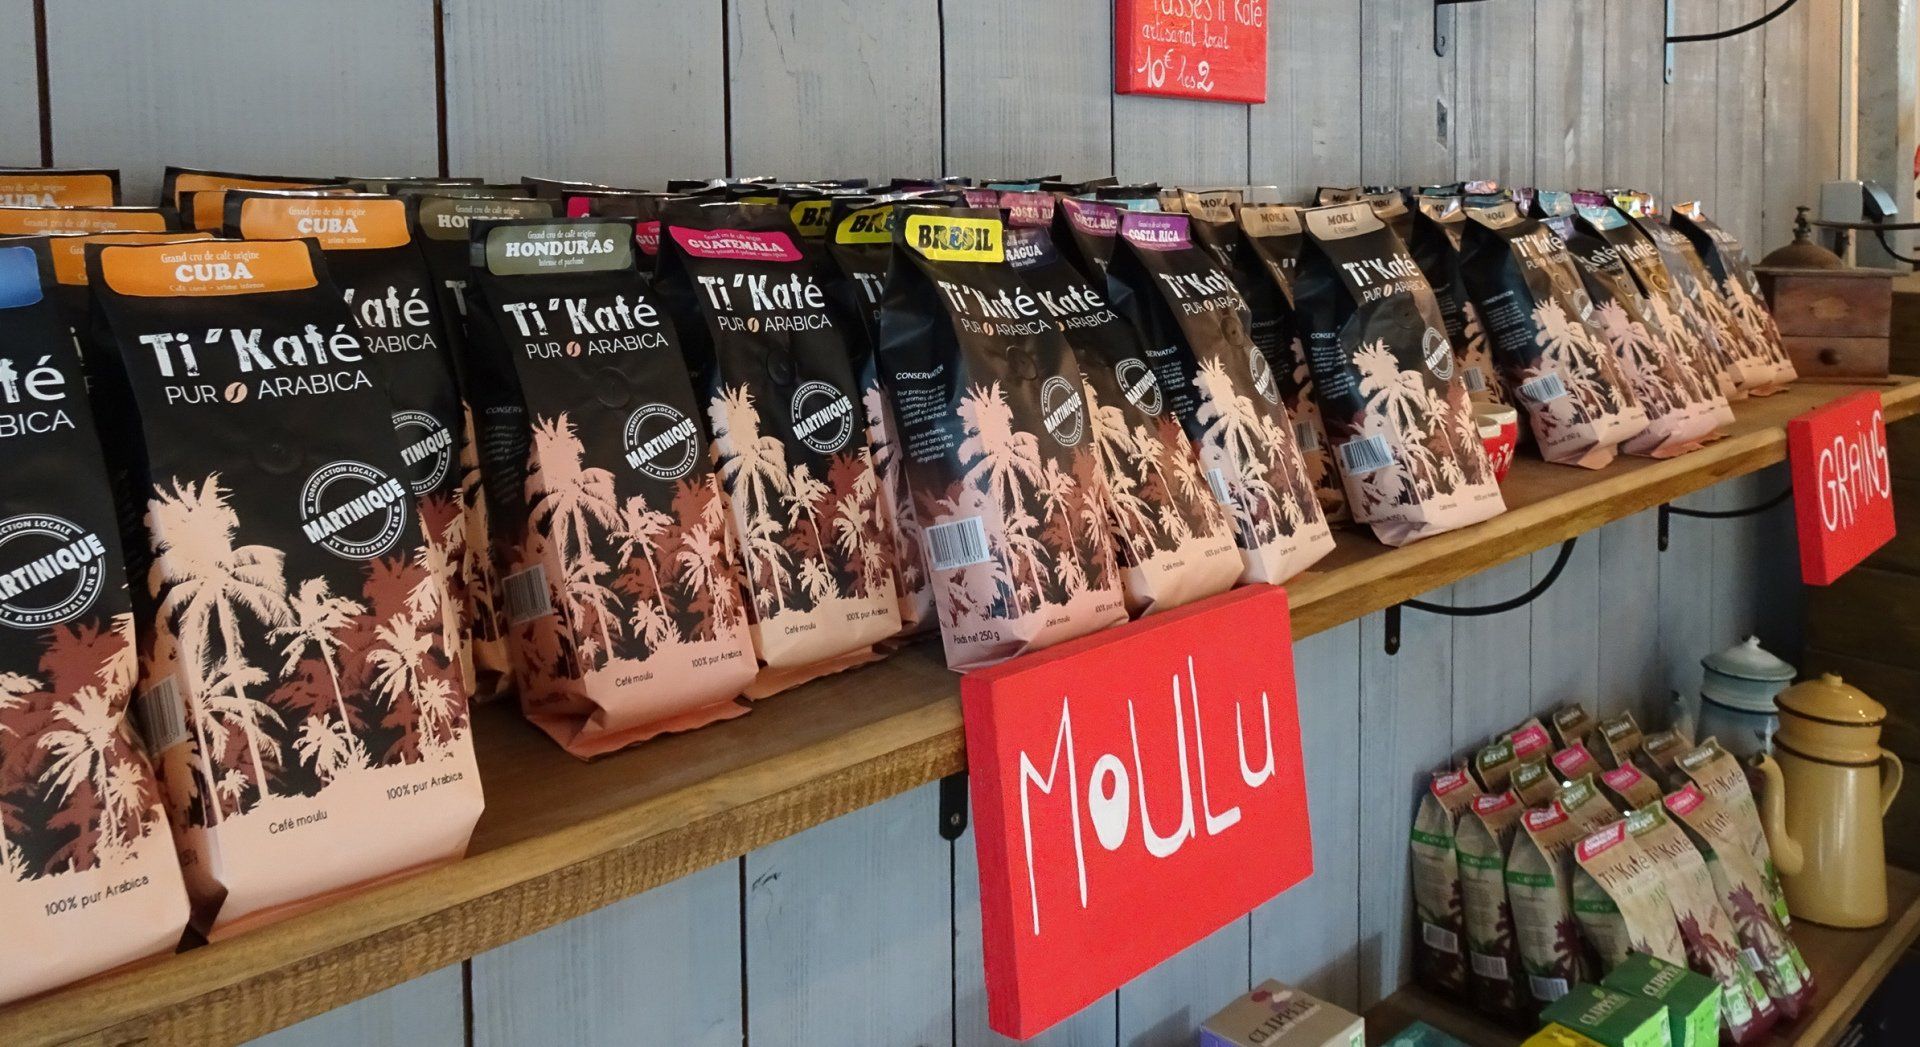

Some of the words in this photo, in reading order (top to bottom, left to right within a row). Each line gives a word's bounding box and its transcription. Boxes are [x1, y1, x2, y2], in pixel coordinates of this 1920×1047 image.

[1010, 206, 1039, 219] COSTA
[1200, 197, 1229, 209] MOKA
[297, 217, 359, 234] CUBA
[1260, 213, 1290, 224] MOKA
[1327, 213, 1356, 226] MOKA
[1128, 228, 1156, 242] COSTA
[1158, 229, 1180, 242] RICA
[505, 238, 615, 258] HONDURAS
[687, 238, 785, 253] GUATEMALA
[1005, 244, 1043, 262] RAGUA
[175, 262, 254, 283] CUBA
[1363, 287, 1382, 303] PUR
[1182, 301, 1204, 317] PUR
[718, 316, 746, 332] PUR
[764, 313, 833, 333] ARABICA
[961, 317, 982, 335] PUR
[995, 317, 1052, 337] ARABICA
[1065, 308, 1119, 331] ARABICA
[367, 333, 437, 353] RABICA
[526, 341, 562, 360] PUR
[588, 333, 669, 356] ARABICA
[165, 384, 219, 406] PUR
[257, 369, 373, 400] ARABICA
[792, 395, 853, 441] MARTINIQUE
[1044, 391, 1082, 434] MARTINIQUE
[400, 428, 453, 466] TINIQUE
[625, 417, 698, 469] MARTINIQUE
[349, 465, 378, 479] LOCALE
[302, 478, 406, 544] MARTINIQUE
[34, 520, 73, 536] LOCALE
[343, 528, 395, 554] ARTISANALE
[0, 533, 106, 600] RTINIQUE
[15, 594, 87, 622] ARTISANALE
[386, 782, 411, 801] 100%
[412, 779, 429, 798] pur
[430, 770, 464, 792] Arabica
[269, 814, 293, 837] Café
[295, 808, 328, 832] moulu
[44, 893, 78, 917] 100%
[81, 889, 103, 909] pur
[105, 874, 150, 899] Arabica
[1249, 998, 1316, 1044] CLIPPER
